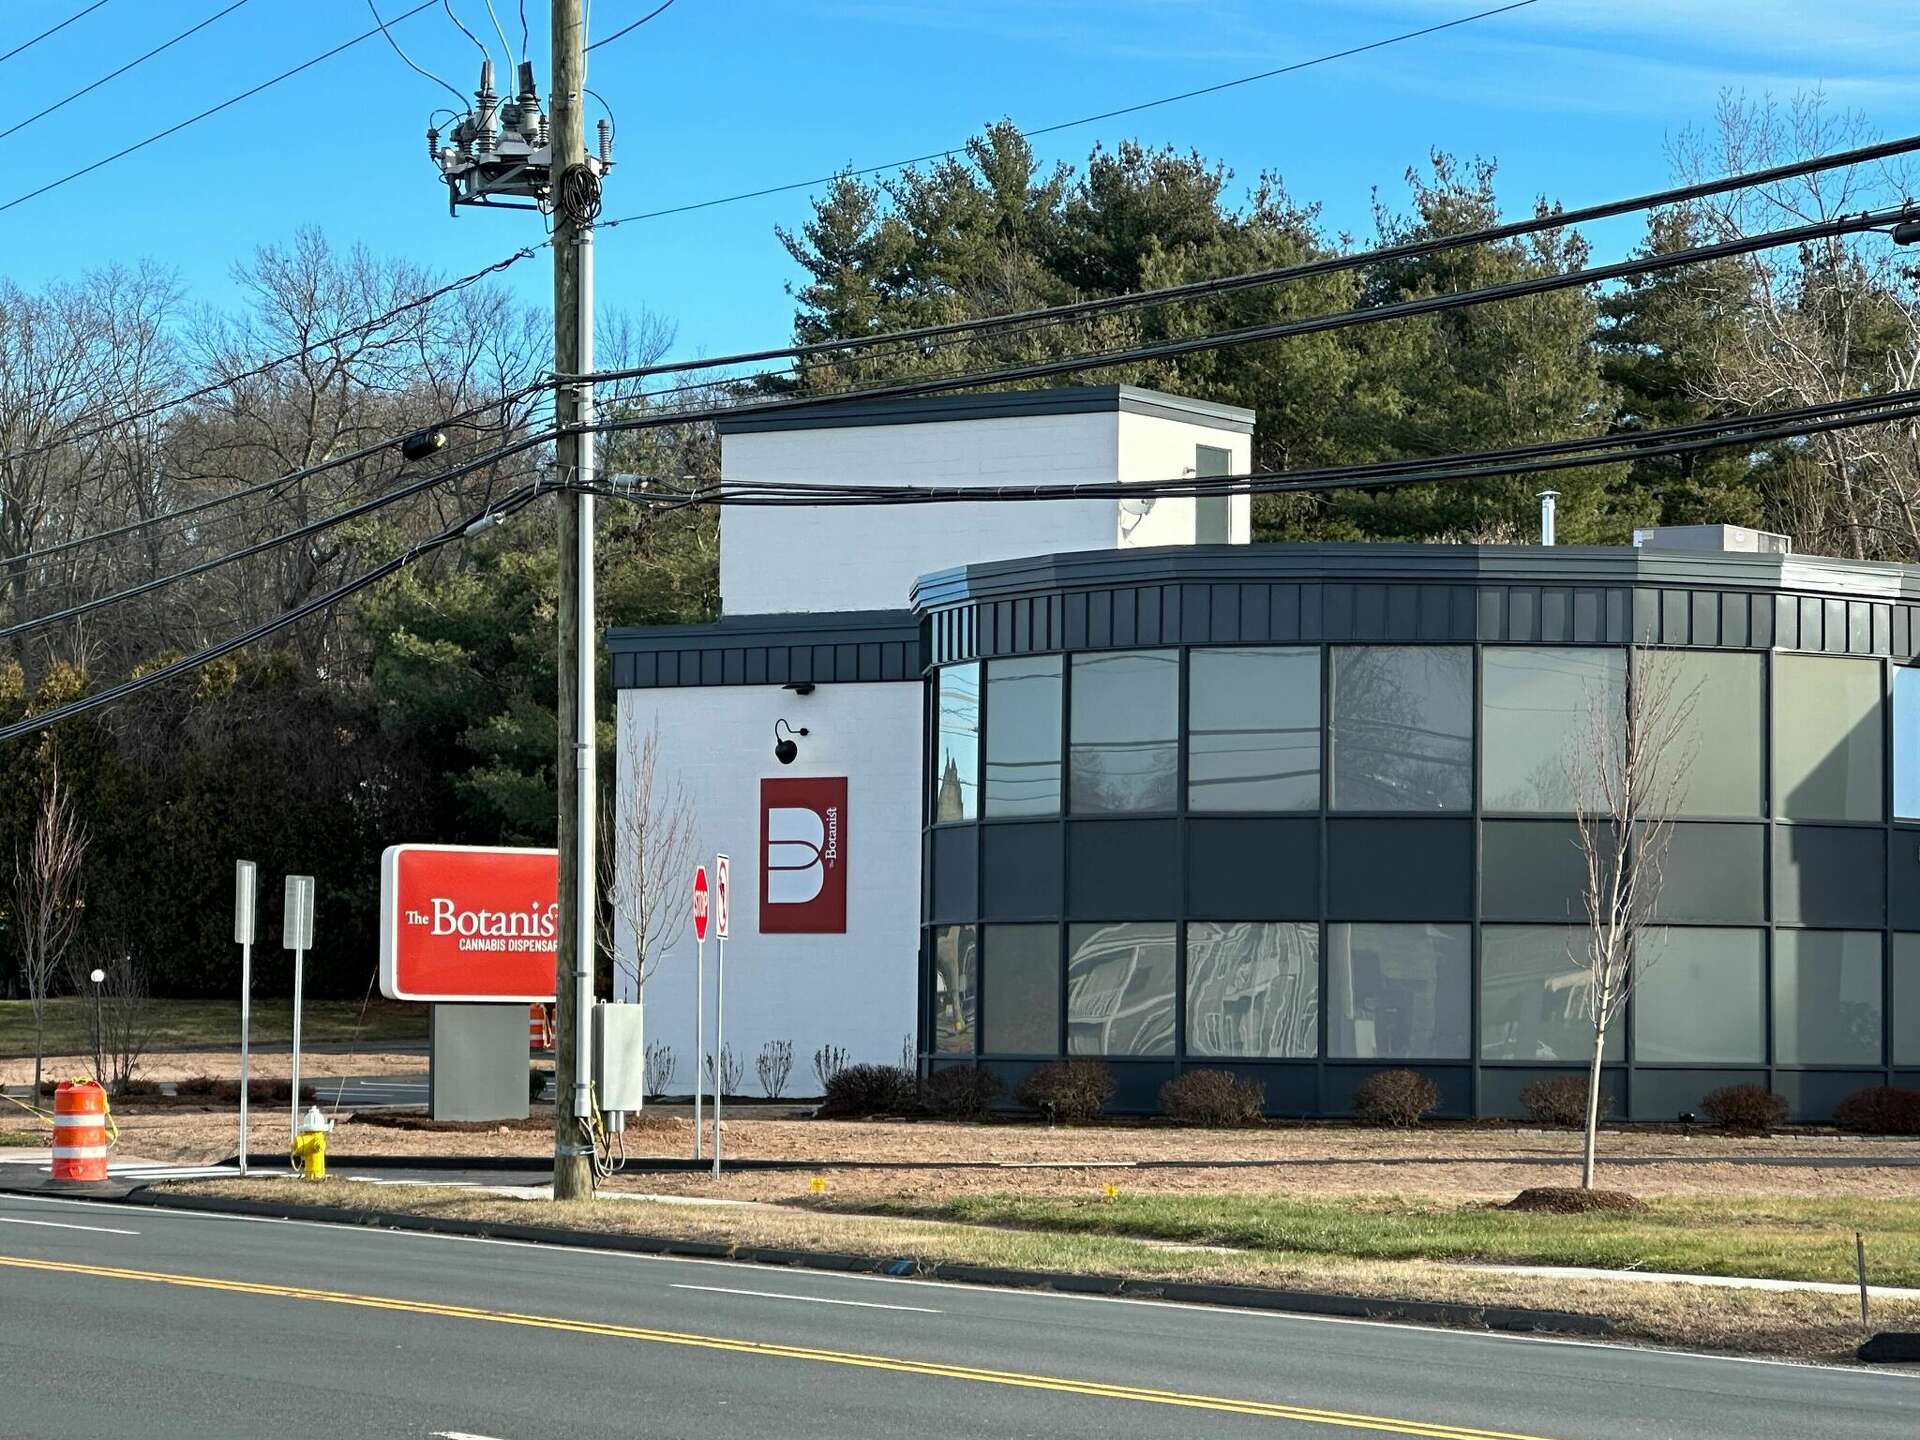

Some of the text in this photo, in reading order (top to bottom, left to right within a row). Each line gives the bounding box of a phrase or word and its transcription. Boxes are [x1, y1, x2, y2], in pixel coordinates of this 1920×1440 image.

[825, 807, 837, 860] Botanist
[405, 898, 558, 937] The Botanis
[695, 890, 709, 918] STOP
[459, 938, 558, 953] CANNABIS DISPENSAR
